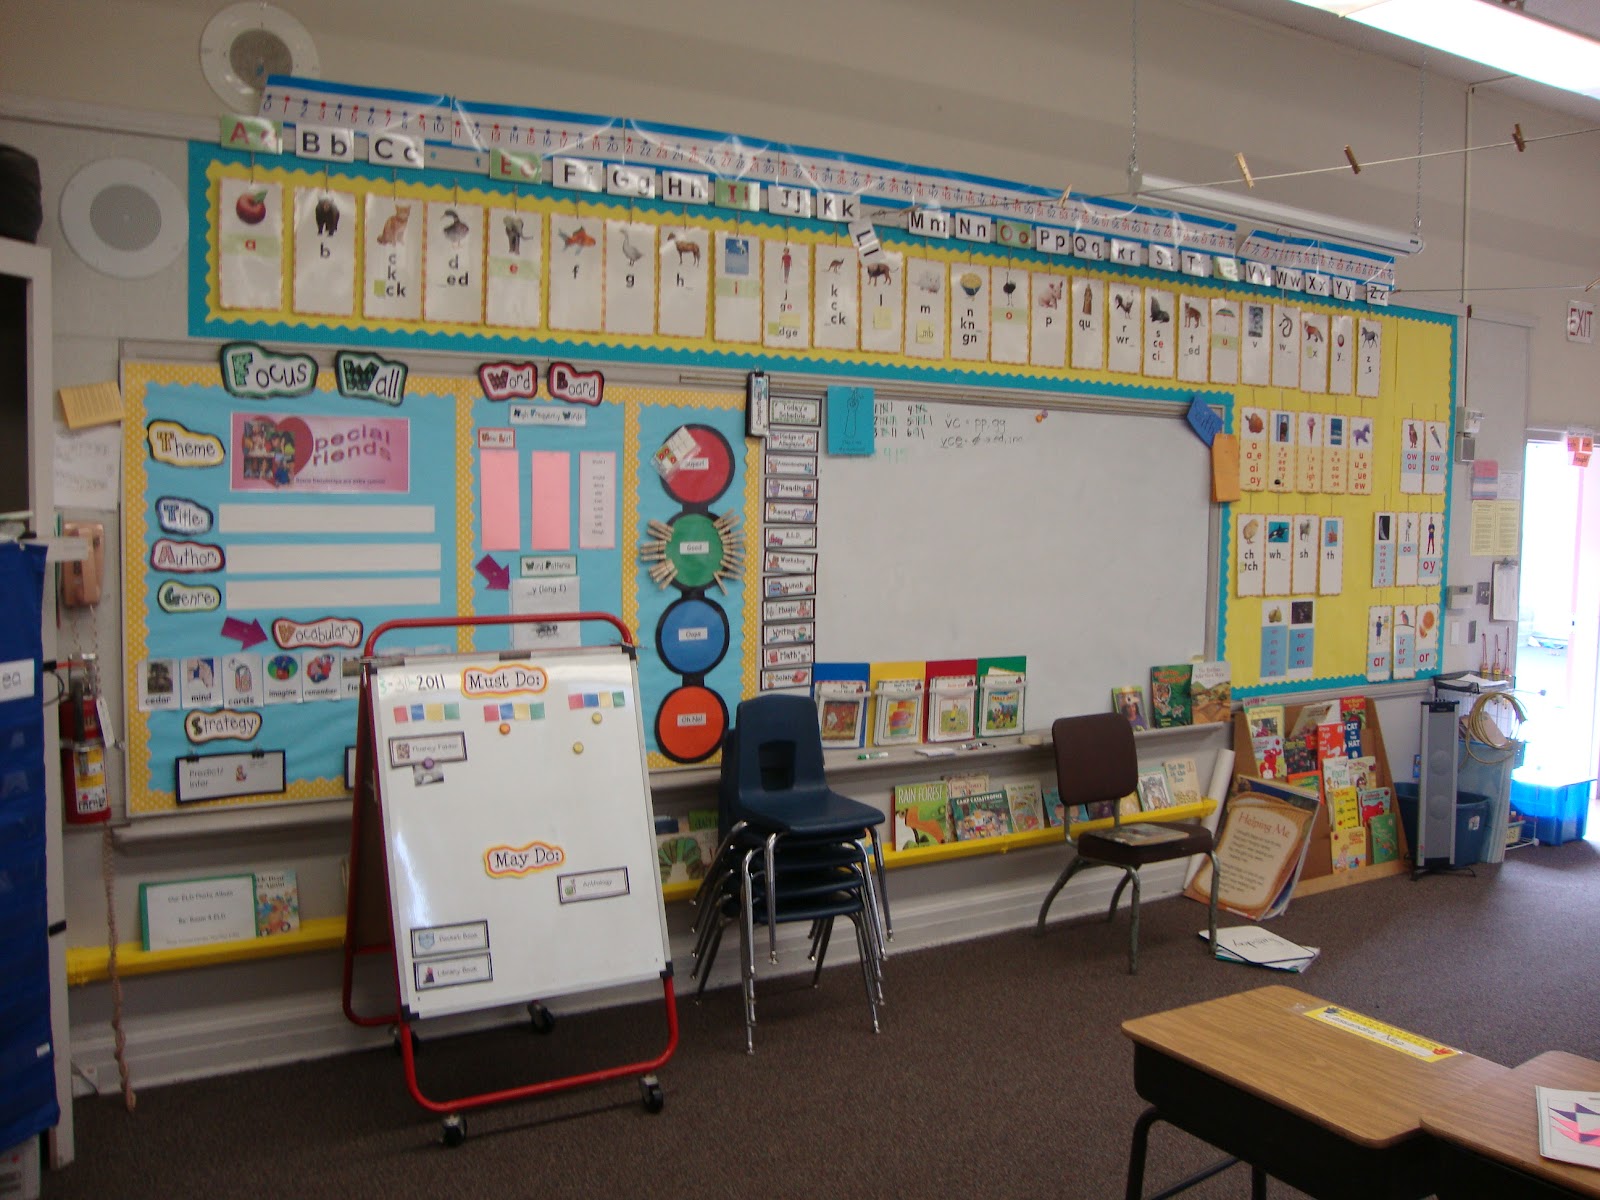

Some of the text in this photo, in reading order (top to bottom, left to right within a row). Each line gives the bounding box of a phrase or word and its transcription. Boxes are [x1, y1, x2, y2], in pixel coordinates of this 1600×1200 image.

[245, 239, 257, 251] a
[319, 243, 331, 259] b
[388, 253, 397, 266] c
[449, 254, 459, 270] d
[386, 266, 397, 281] k
[509, 263, 519, 275] e
[571, 265, 581, 280] f
[625, 274, 637, 289] g
[831, 283, 838, 297] k
[920, 304, 931, 314] m
[966, 308, 974, 317] n
[1005, 311, 1013, 320] o
[1045, 316, 1053, 328] p
[1569, 308, 1594, 338] EXIT
[962, 333, 977, 346] gn
[231, 351, 400, 400] Focus Wall
[488, 369, 597, 399] Word Board
[156, 431, 216, 459] Theme
[1244, 550, 1254, 559] ch
[1299, 550, 1309, 559] sh
[1326, 551, 1335, 560] th
[1422, 560, 1436, 574] oy
[1373, 656, 1385, 667] ar
[1419, 652, 1430, 663] or
[468, 670, 541, 691] Must Do:
[191, 692, 213, 704] mind
[1346, 722, 1358, 731] CAT
[1347, 740, 1360, 748] HAT
[898, 784, 943, 804] RAIN FOREST
[1238, 811, 1291, 839] Helping Me
[494, 846, 560, 869] May Do:
